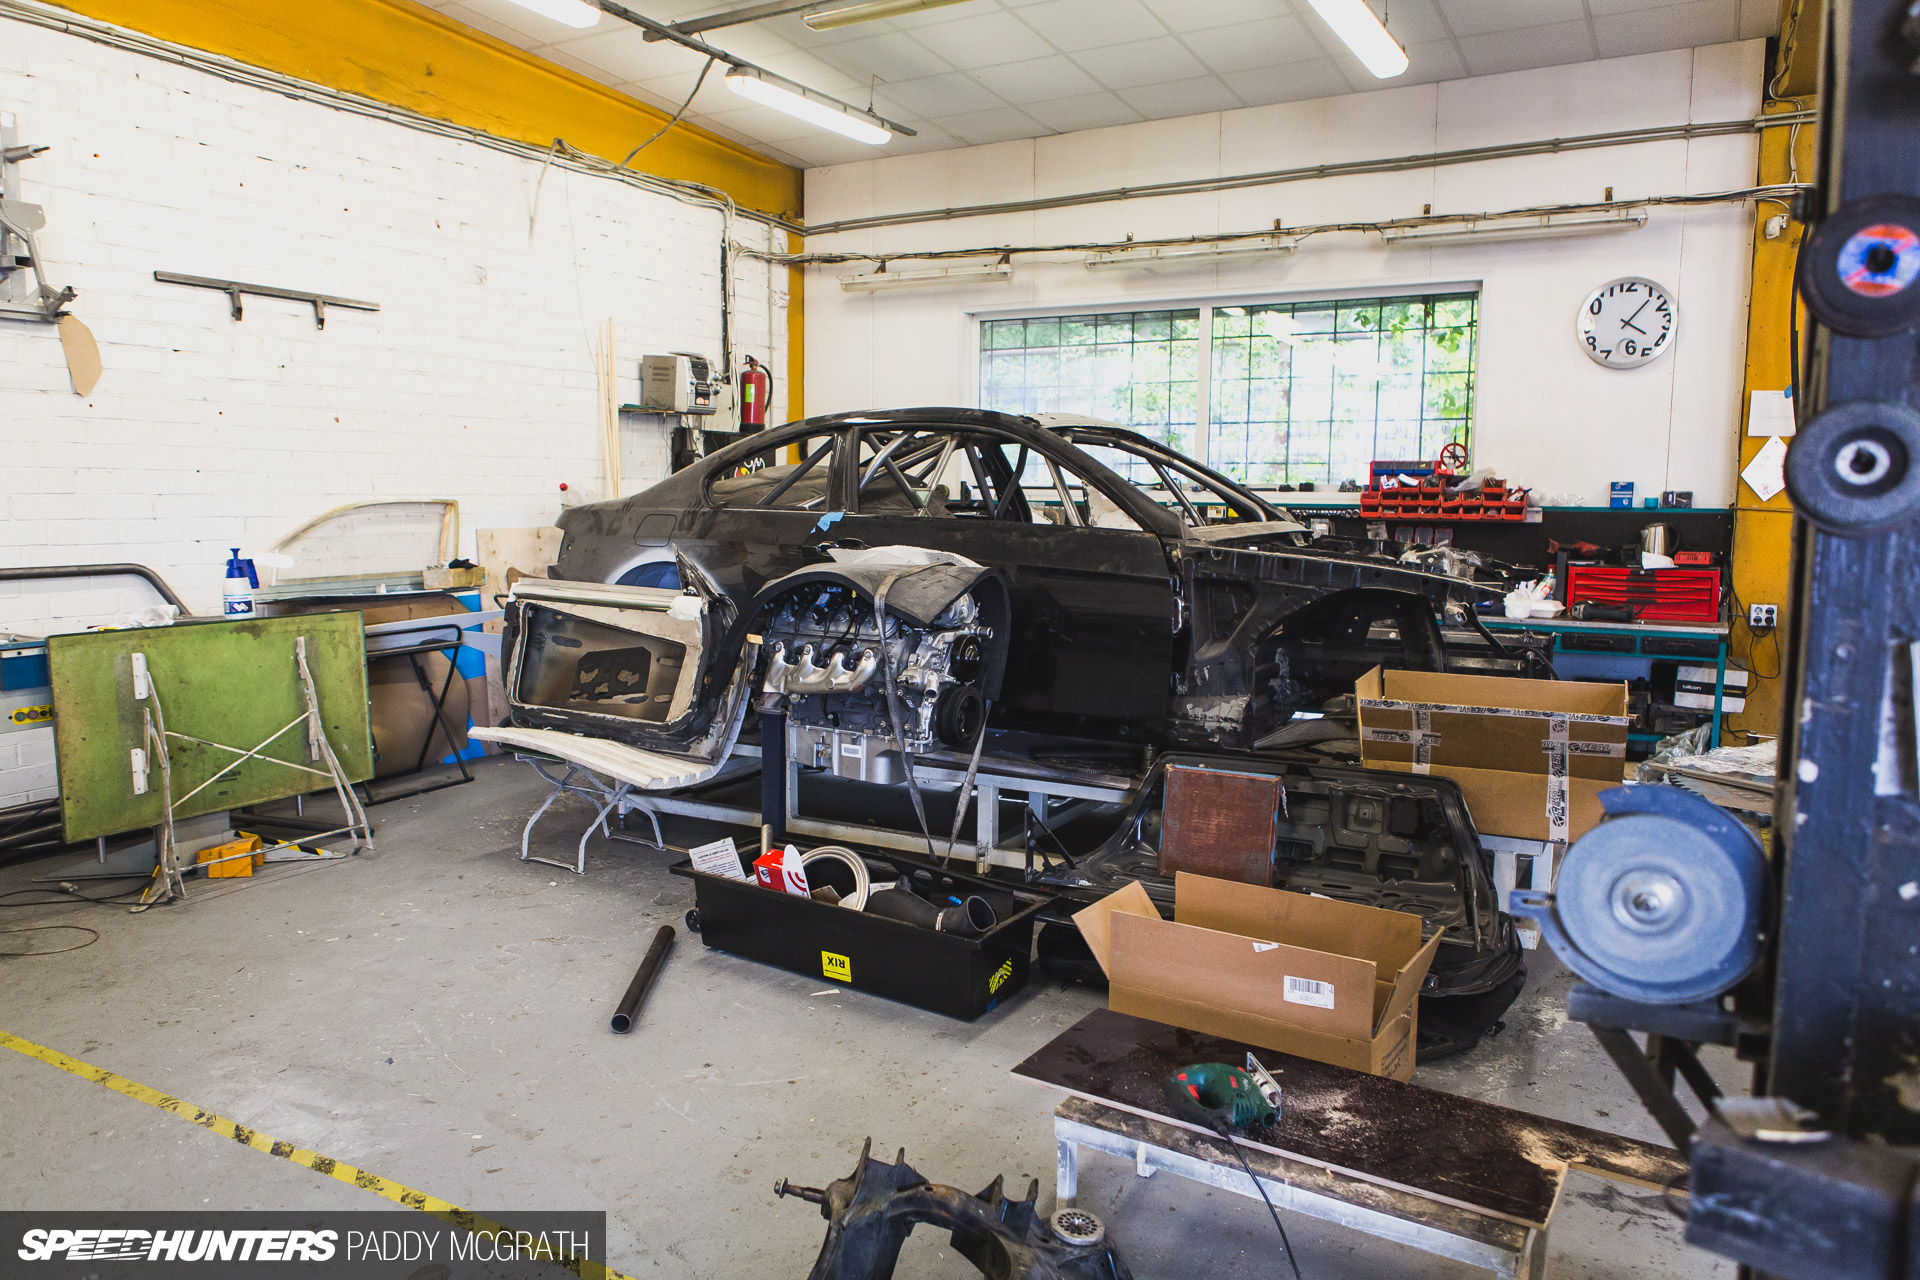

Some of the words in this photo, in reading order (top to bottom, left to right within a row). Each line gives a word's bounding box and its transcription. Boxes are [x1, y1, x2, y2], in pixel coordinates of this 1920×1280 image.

[1620, 282, 1638, 293] 12
[1655, 294, 1669, 312] 2
[1661, 312, 1671, 331] 3
[1654, 332, 1667, 347] 4
[1625, 339, 1637, 356] 6
[1580, 742, 1612, 752] FEAL
[827, 955, 846, 969] RIX
